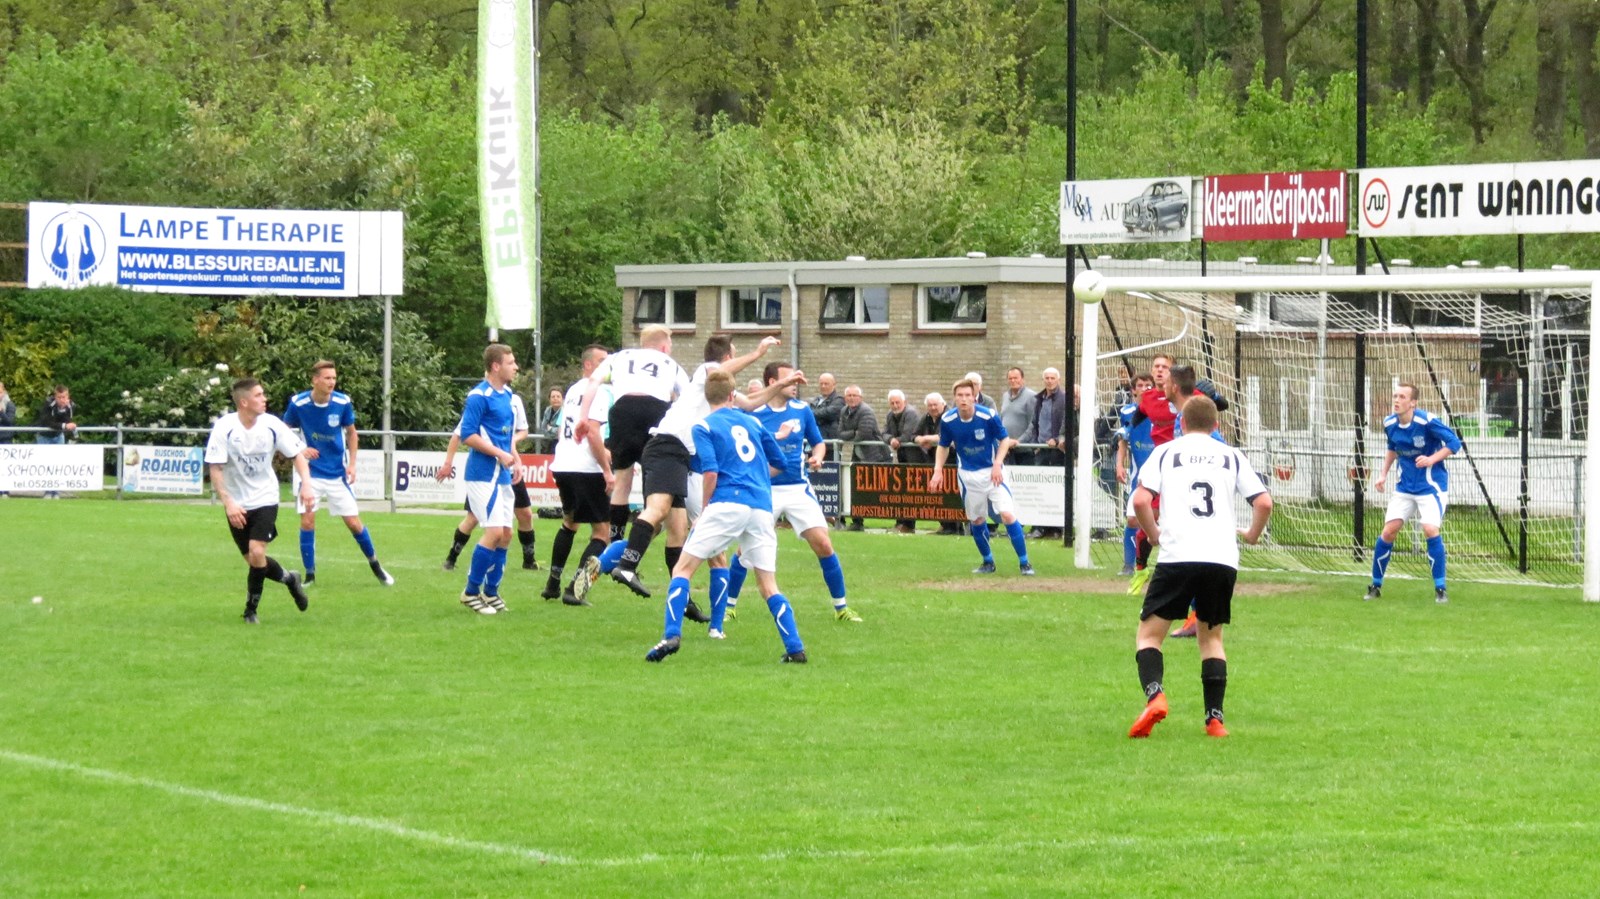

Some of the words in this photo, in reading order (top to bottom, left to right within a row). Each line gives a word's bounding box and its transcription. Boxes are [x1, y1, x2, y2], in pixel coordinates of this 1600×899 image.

[1204, 172, 1344, 237] kleermakerijbos.nl
[1397, 182, 1463, 219] SENT
[119, 212, 209, 240] LAMPE
[216, 215, 344, 243] THERAPIE
[119, 252, 343, 273] WWW.BLESSUREBALIE.NL
[120, 270, 136, 279] Het
[138, 271, 222, 283] sportersspreekuur:
[223, 273, 249, 282] maak
[251, 275, 268, 283] een
[270, 274, 298, 283] online
[300, 274, 341, 285] afspraak
[628, 359, 659, 378] 14
[0, 448, 34, 460] DRIJF
[730, 425, 756, 462] 8
[140, 458, 201, 474] ROANCO
[395, 460, 457, 491] BENJAMS
[855, 465, 902, 492] ELIM'S
[1190, 479, 1215, 519] 3
